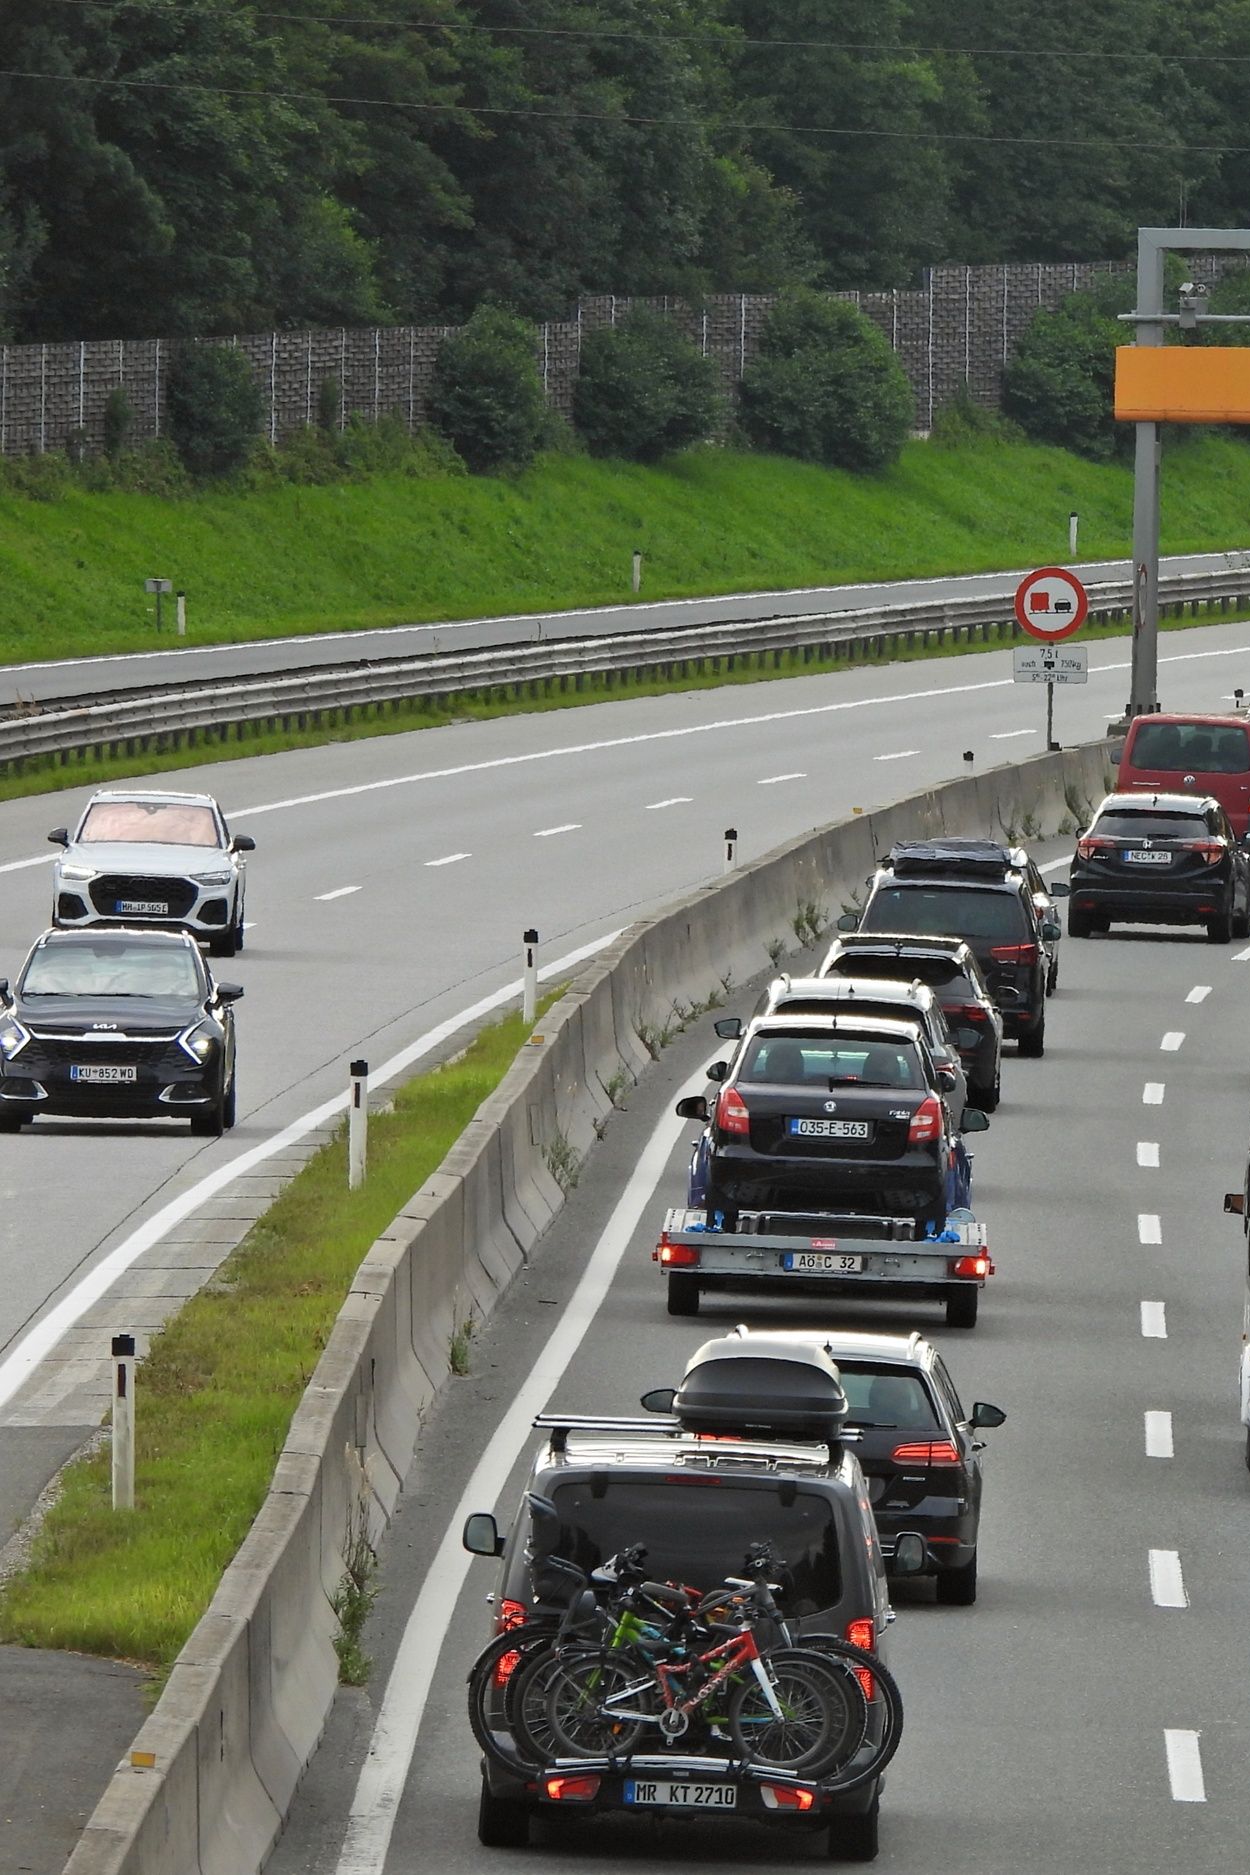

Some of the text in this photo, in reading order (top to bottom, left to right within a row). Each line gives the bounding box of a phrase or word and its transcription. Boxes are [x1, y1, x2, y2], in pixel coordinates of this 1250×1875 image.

[79, 1068, 91, 1078] KU
[800, 1120, 866, 1136] 035-E-563
[824, 1256, 832, 1268] C
[839, 1257, 856, 1270] 32
[636, 1784, 657, 1801] MR
[670, 1785, 690, 1803] KT
[694, 1786, 735, 1806] 2710
